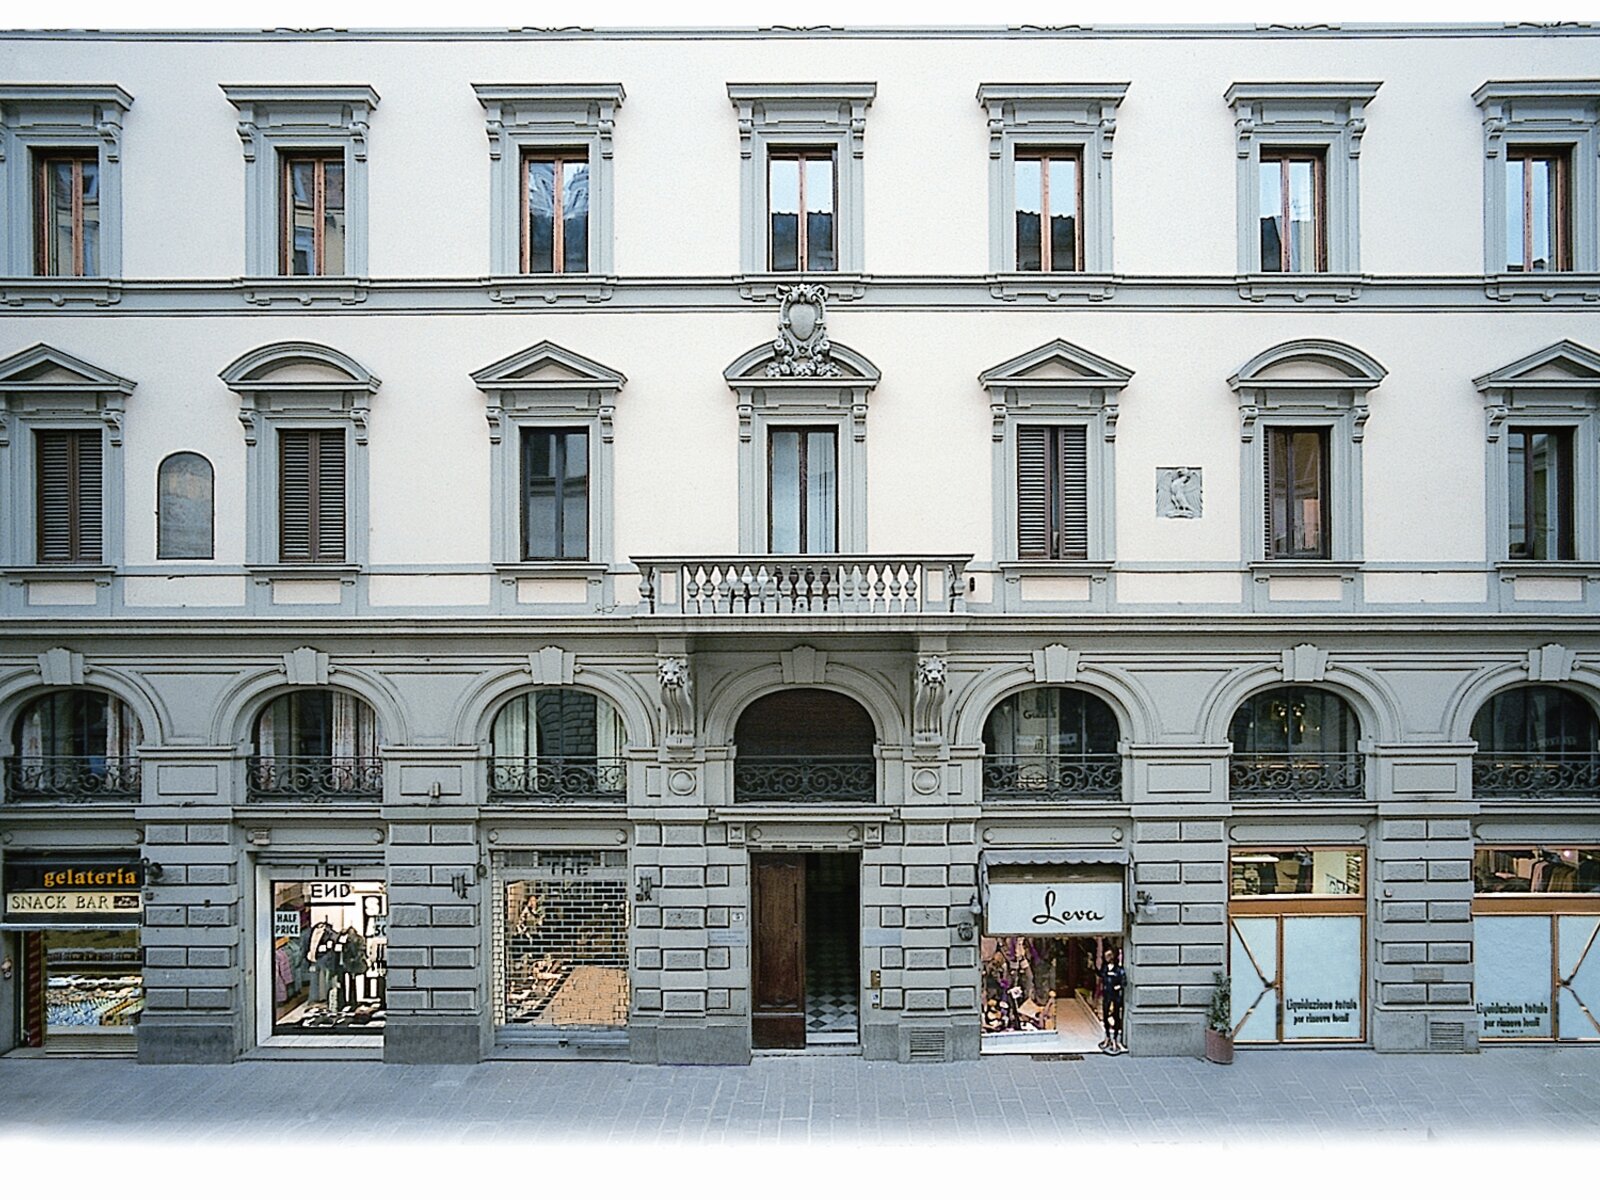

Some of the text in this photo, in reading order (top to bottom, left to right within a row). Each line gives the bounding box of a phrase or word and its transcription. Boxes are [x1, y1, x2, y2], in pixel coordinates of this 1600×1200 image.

[43, 868, 137, 888] gelateria
[12, 895, 67, 909] SNACK
[75, 895, 109, 909] BAR
[1032, 890, 1105, 925] Leva
[277, 914, 297, 923] HALF
[275, 924, 299, 935] PRICE
